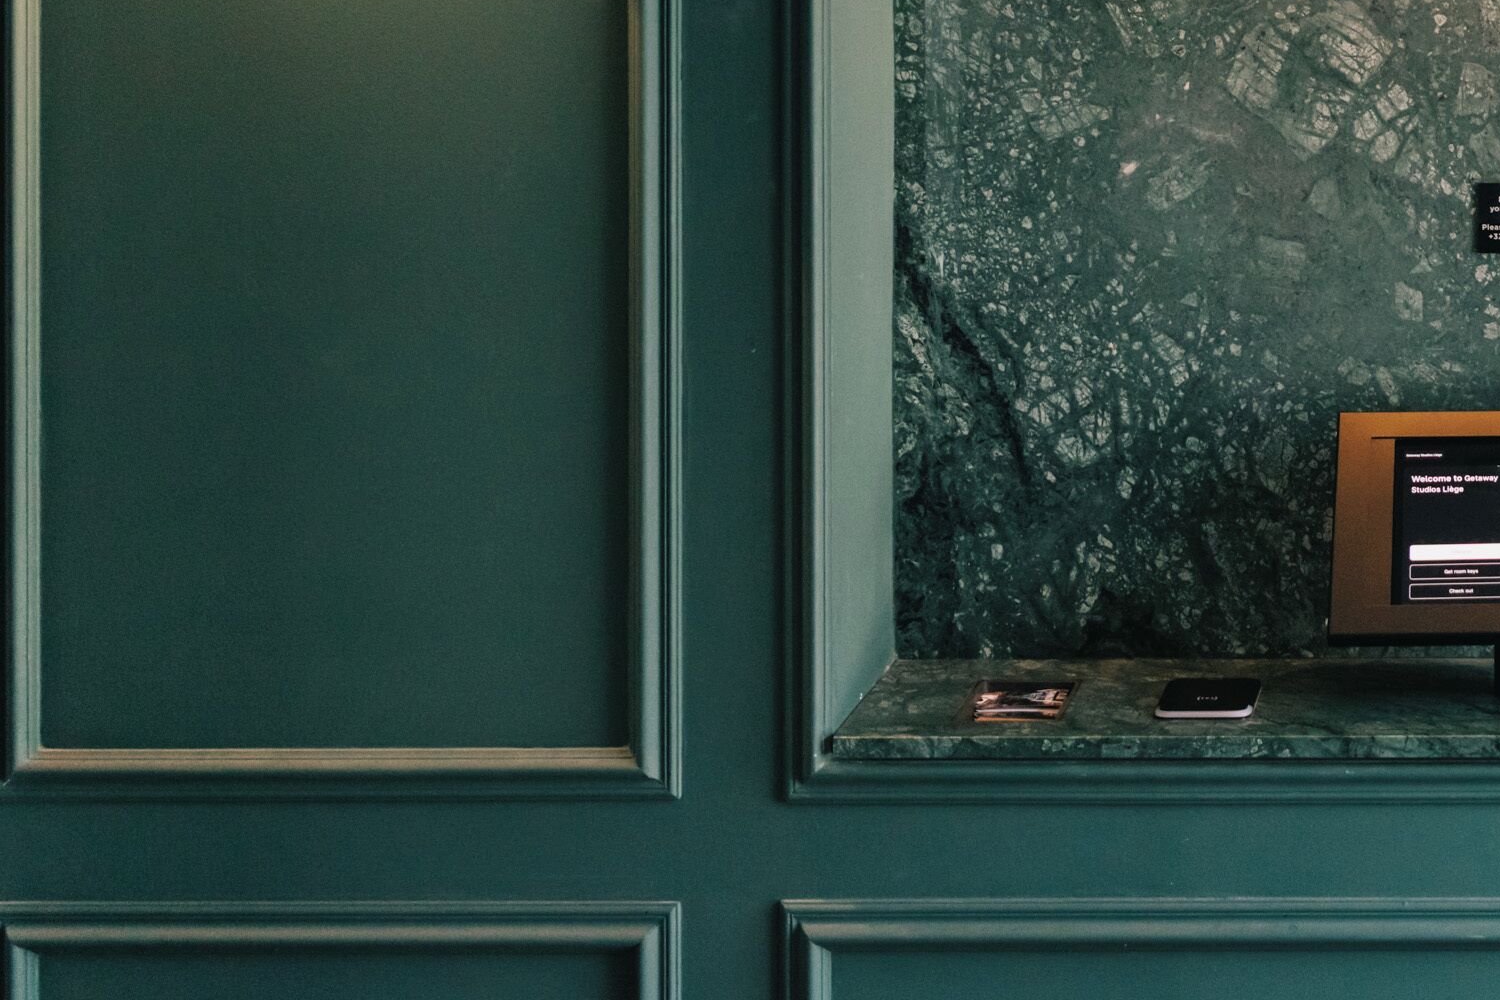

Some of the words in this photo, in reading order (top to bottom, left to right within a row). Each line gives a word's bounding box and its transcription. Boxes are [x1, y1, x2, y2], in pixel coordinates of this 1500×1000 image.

[1411, 475, 1452, 483] Welcome
[1464, 474, 1499, 483] Getaway
[1442, 485, 1465, 494] Liège
